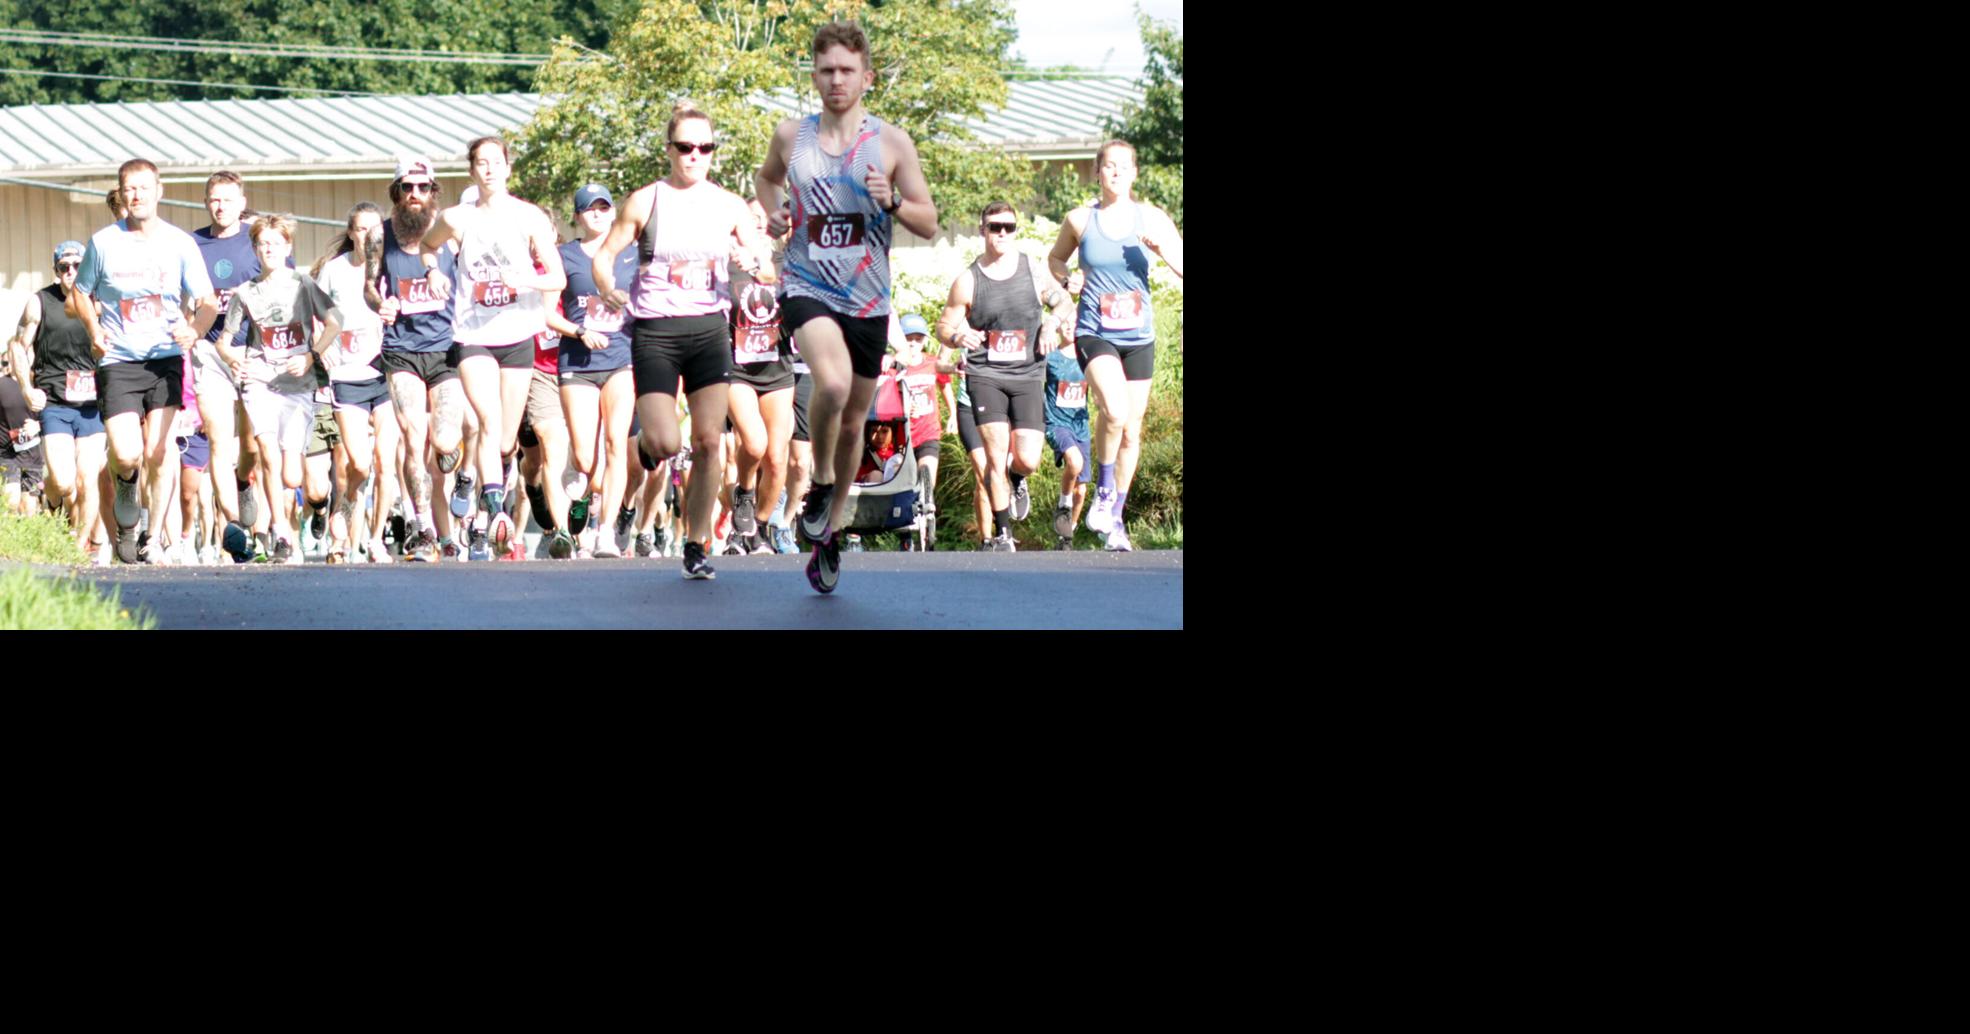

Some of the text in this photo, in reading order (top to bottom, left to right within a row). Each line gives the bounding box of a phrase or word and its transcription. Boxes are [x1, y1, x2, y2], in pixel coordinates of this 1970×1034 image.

[820, 223, 853, 247] 657
[217, 295, 230, 312] 62
[484, 287, 510, 305] 656
[272, 331, 297, 349] 684
[744, 335, 770, 352] 643
[996, 336, 1019, 352] 669
